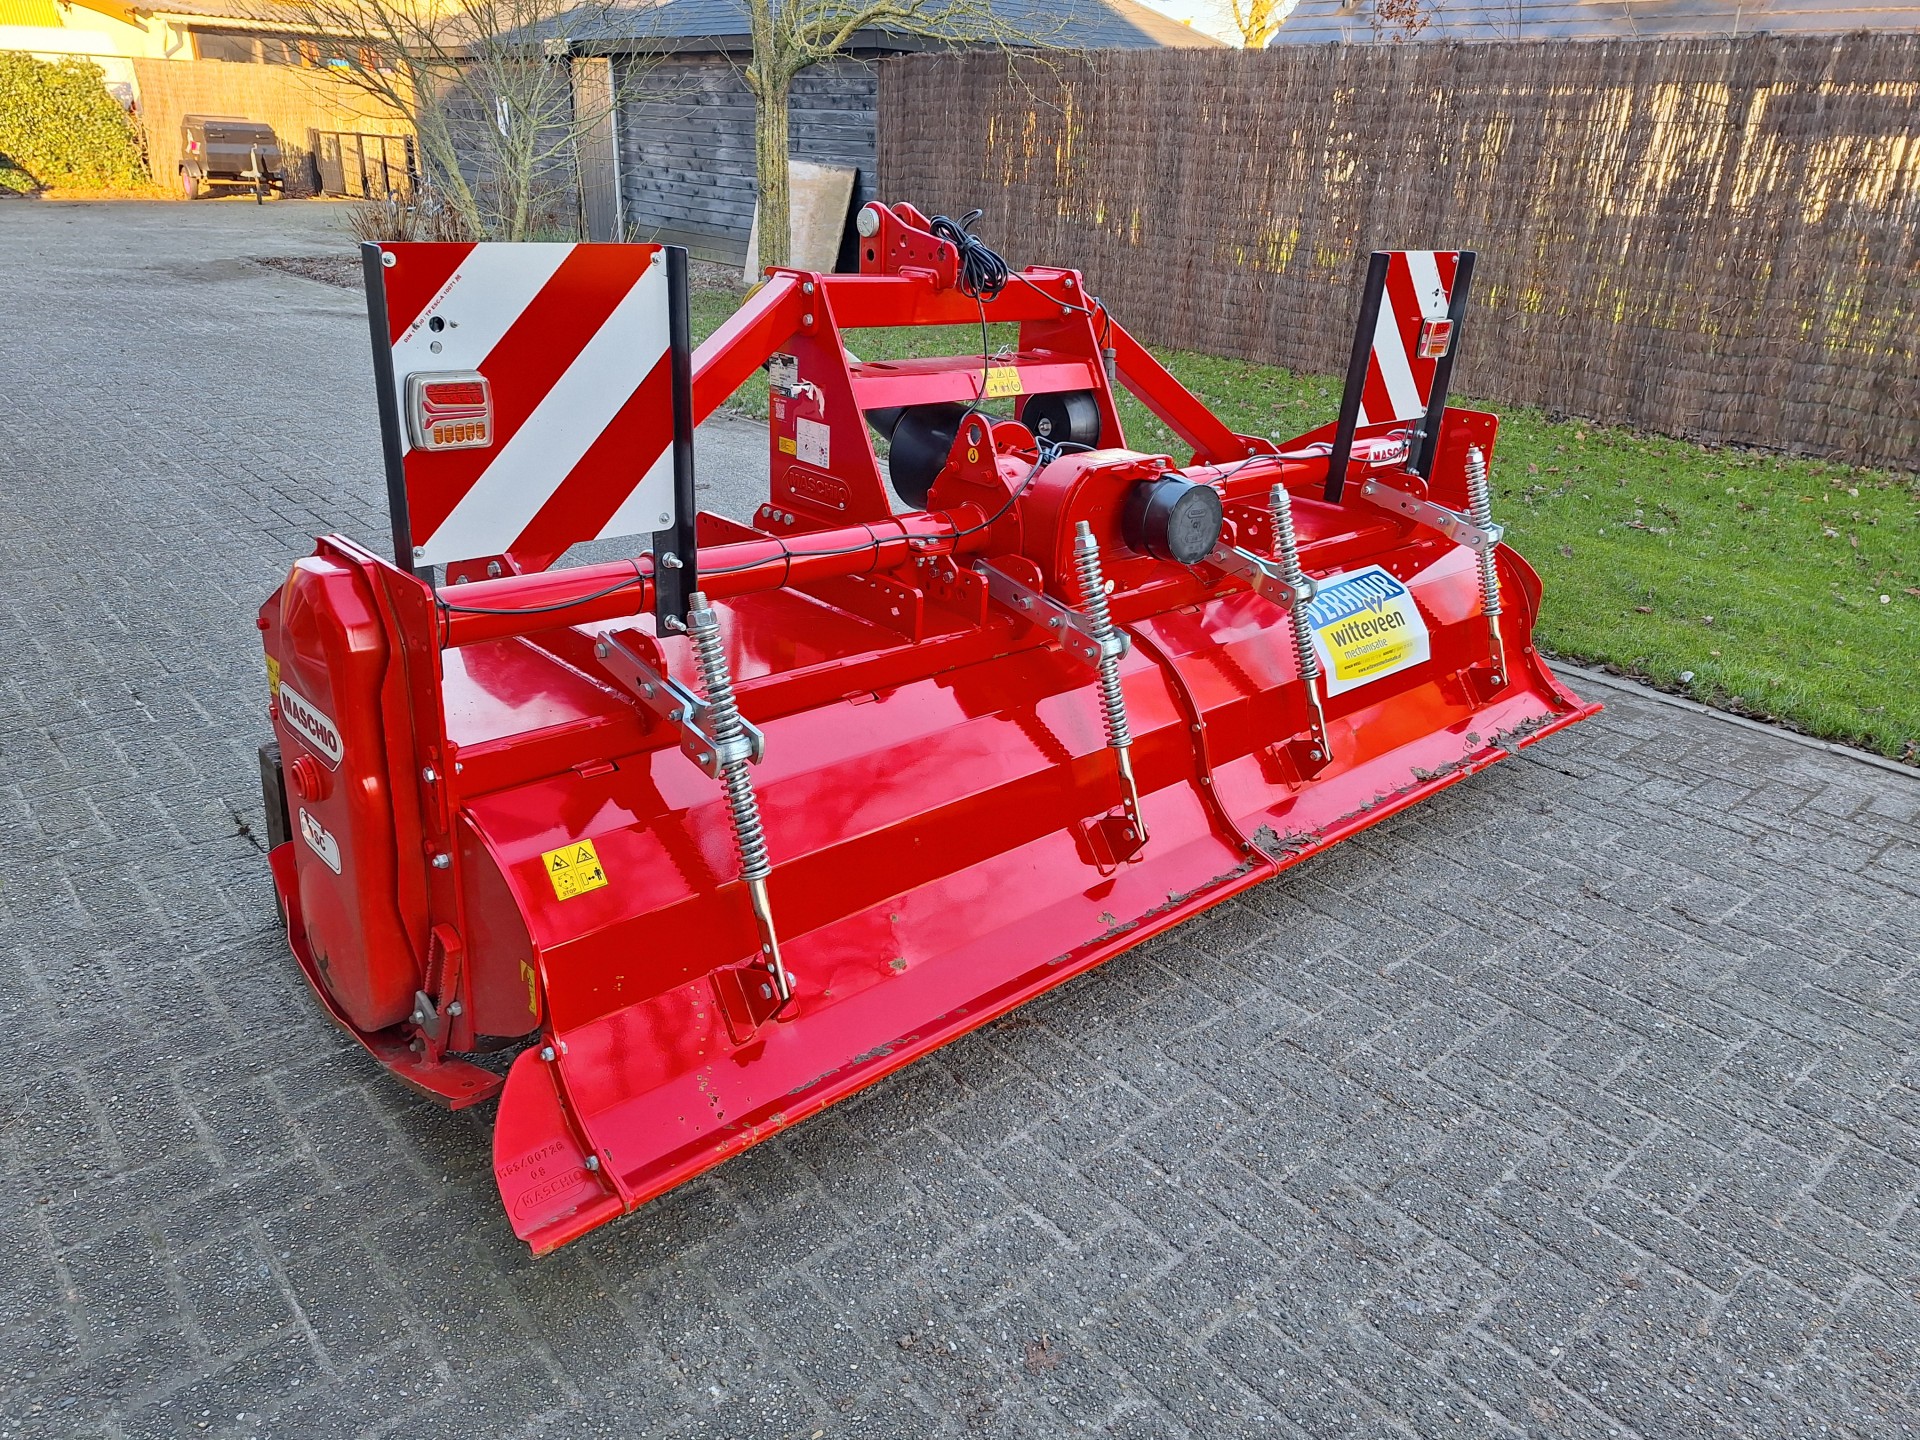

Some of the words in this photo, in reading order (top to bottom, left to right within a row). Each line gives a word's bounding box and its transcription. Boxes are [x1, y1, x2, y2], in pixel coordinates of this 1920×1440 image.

[403, 333, 413, 343] DIN
[1373, 447, 1408, 460] MASC
[788, 471, 848, 501] MASCHIO
[1306, 574, 1400, 624] VERHUUR
[1331, 611, 1405, 647] witteveen
[1345, 637, 1388, 660] mechanisatie
[282, 691, 338, 753] MASCHIO
[563, 888, 577, 896] STOP
[521, 1170, 583, 1207] MASCHIO
